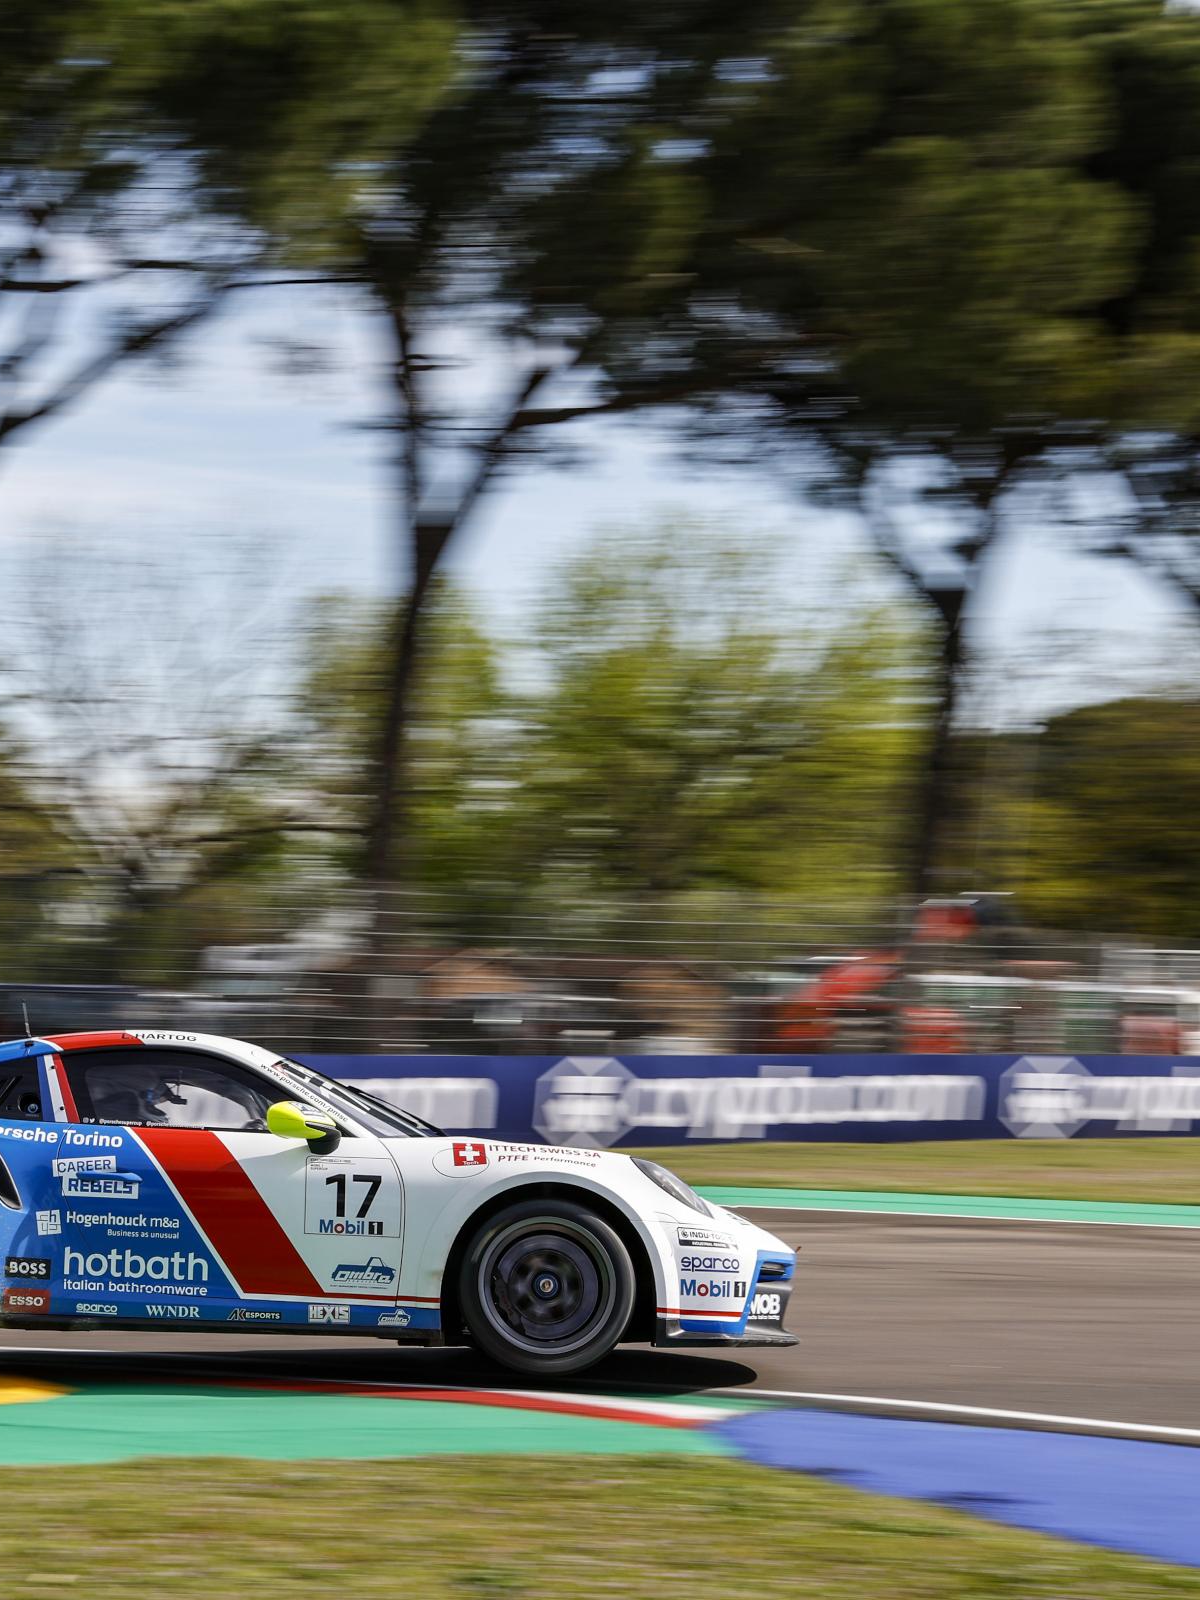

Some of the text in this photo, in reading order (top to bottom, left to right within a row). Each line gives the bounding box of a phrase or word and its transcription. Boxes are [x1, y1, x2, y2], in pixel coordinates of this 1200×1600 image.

[62, 1128, 124, 1148] Torino
[539, 1147, 581, 1156] SWISS
[584, 1151, 602, 1159] SA
[57, 1159, 112, 1174] CAREER
[498, 1154, 597, 1168] PTFE Performance
[68, 1177, 133, 1195] REBELS
[326, 1174, 382, 1218] 17
[66, 1211, 180, 1229] Hogenhouck m&a
[320, 1219, 380, 1235] Mobil 1
[107, 1229, 139, 1237] Business
[150, 1232, 180, 1240] unusual
[9, 1261, 47, 1275] BOSS
[63, 1246, 209, 1281] hotbath
[681, 1256, 740, 1273] sparco
[63, 1279, 208, 1296] italian bathroomware
[681, 1279, 745, 1297] Mobil 1
[9, 1296, 44, 1307] ESSO
[76, 1302, 118, 1315] sparco
[146, 1305, 200, 1318] WNDR
[245, 1311, 281, 1320] ESPORTS
[309, 1305, 349, 1320] HEXIS
